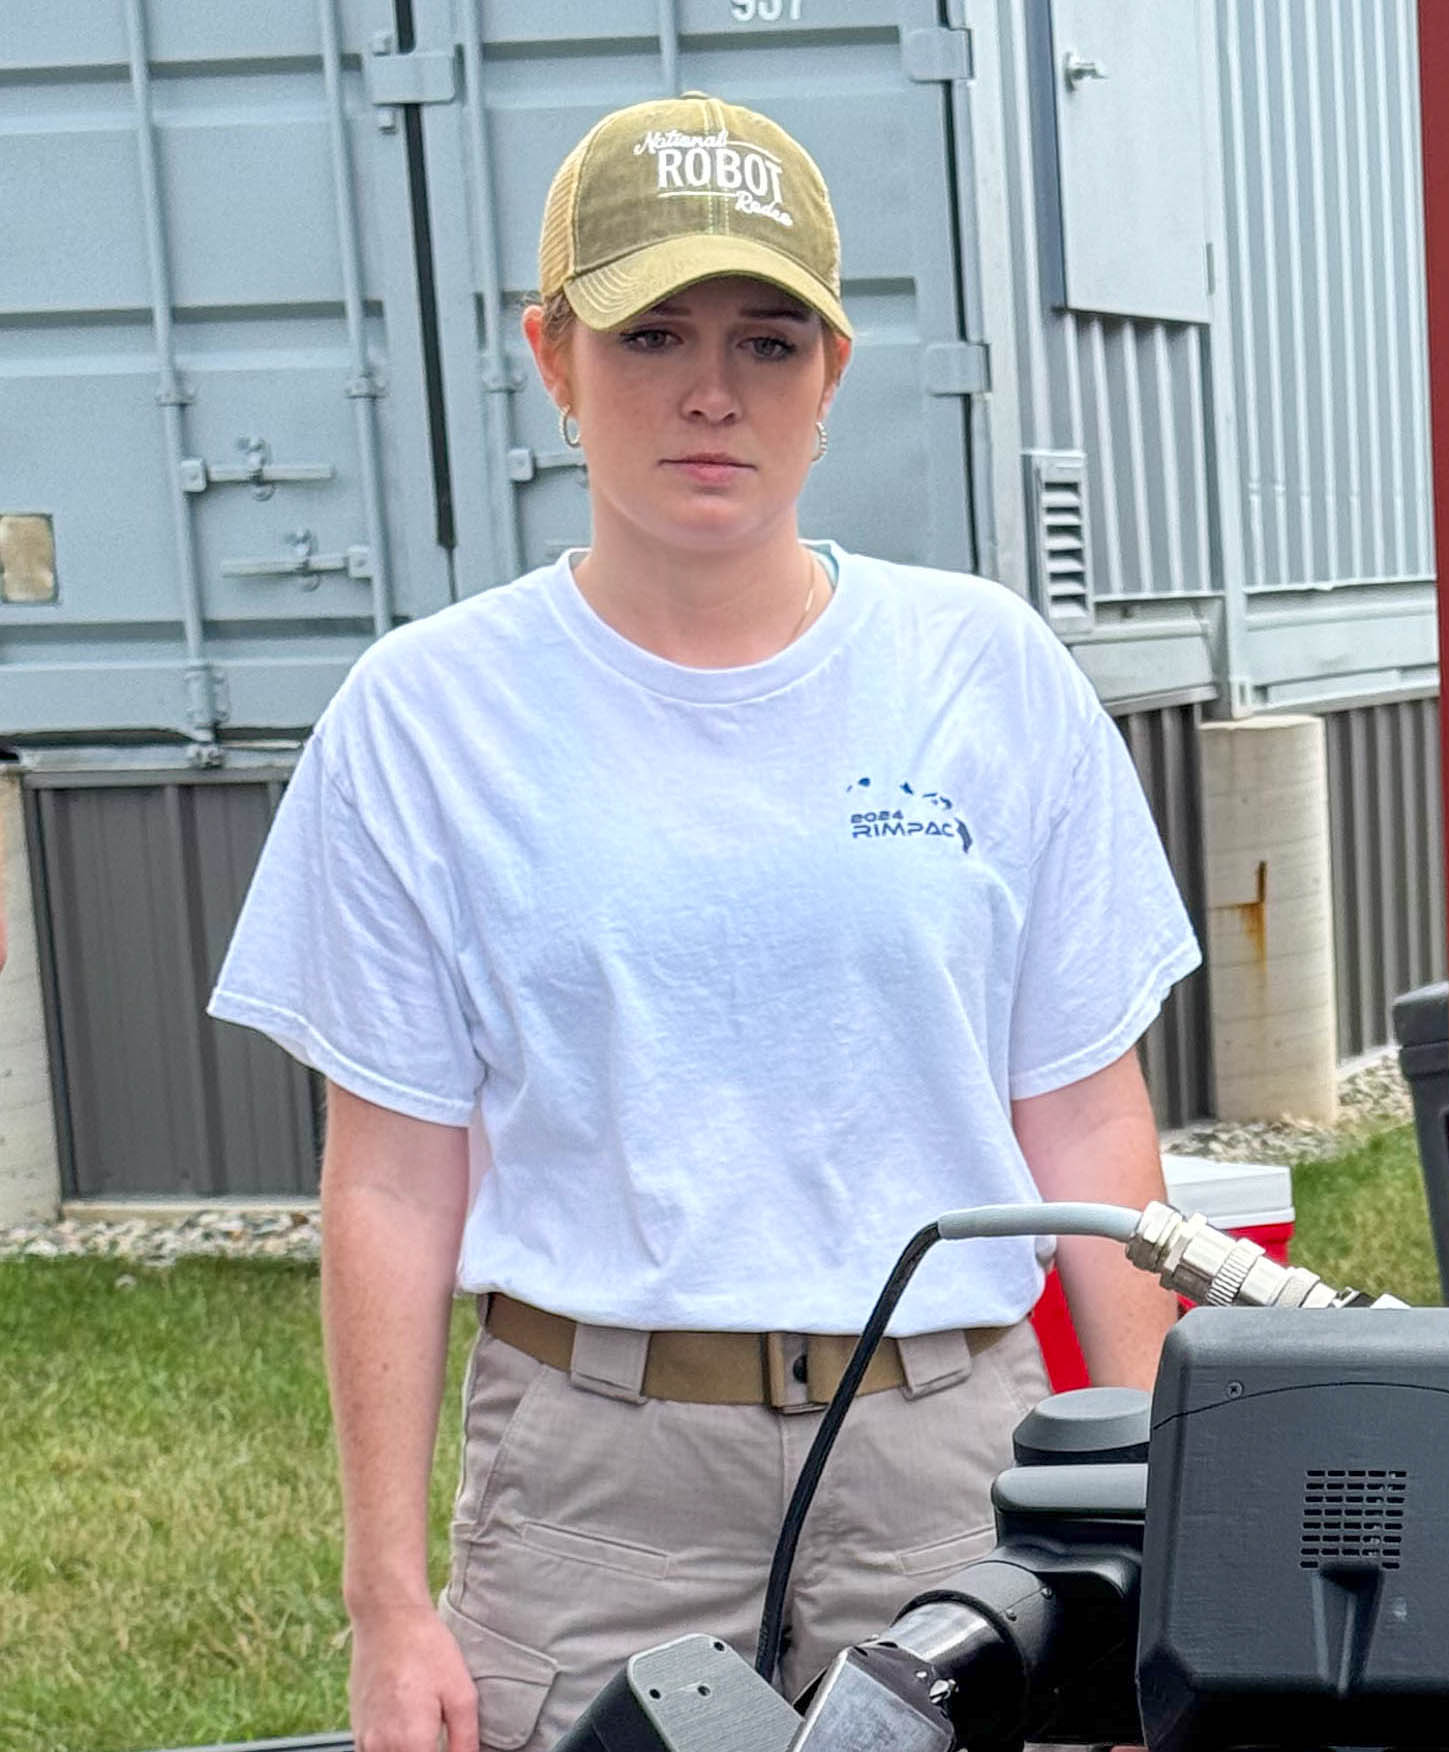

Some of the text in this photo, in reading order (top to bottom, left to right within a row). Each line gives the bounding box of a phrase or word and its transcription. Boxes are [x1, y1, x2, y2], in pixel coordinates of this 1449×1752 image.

[633, 128, 728, 156] National
[656, 147, 783, 204] ROBOT
[735, 190, 793, 227] Rodeo
[852, 822, 955, 839] RIMPAC
